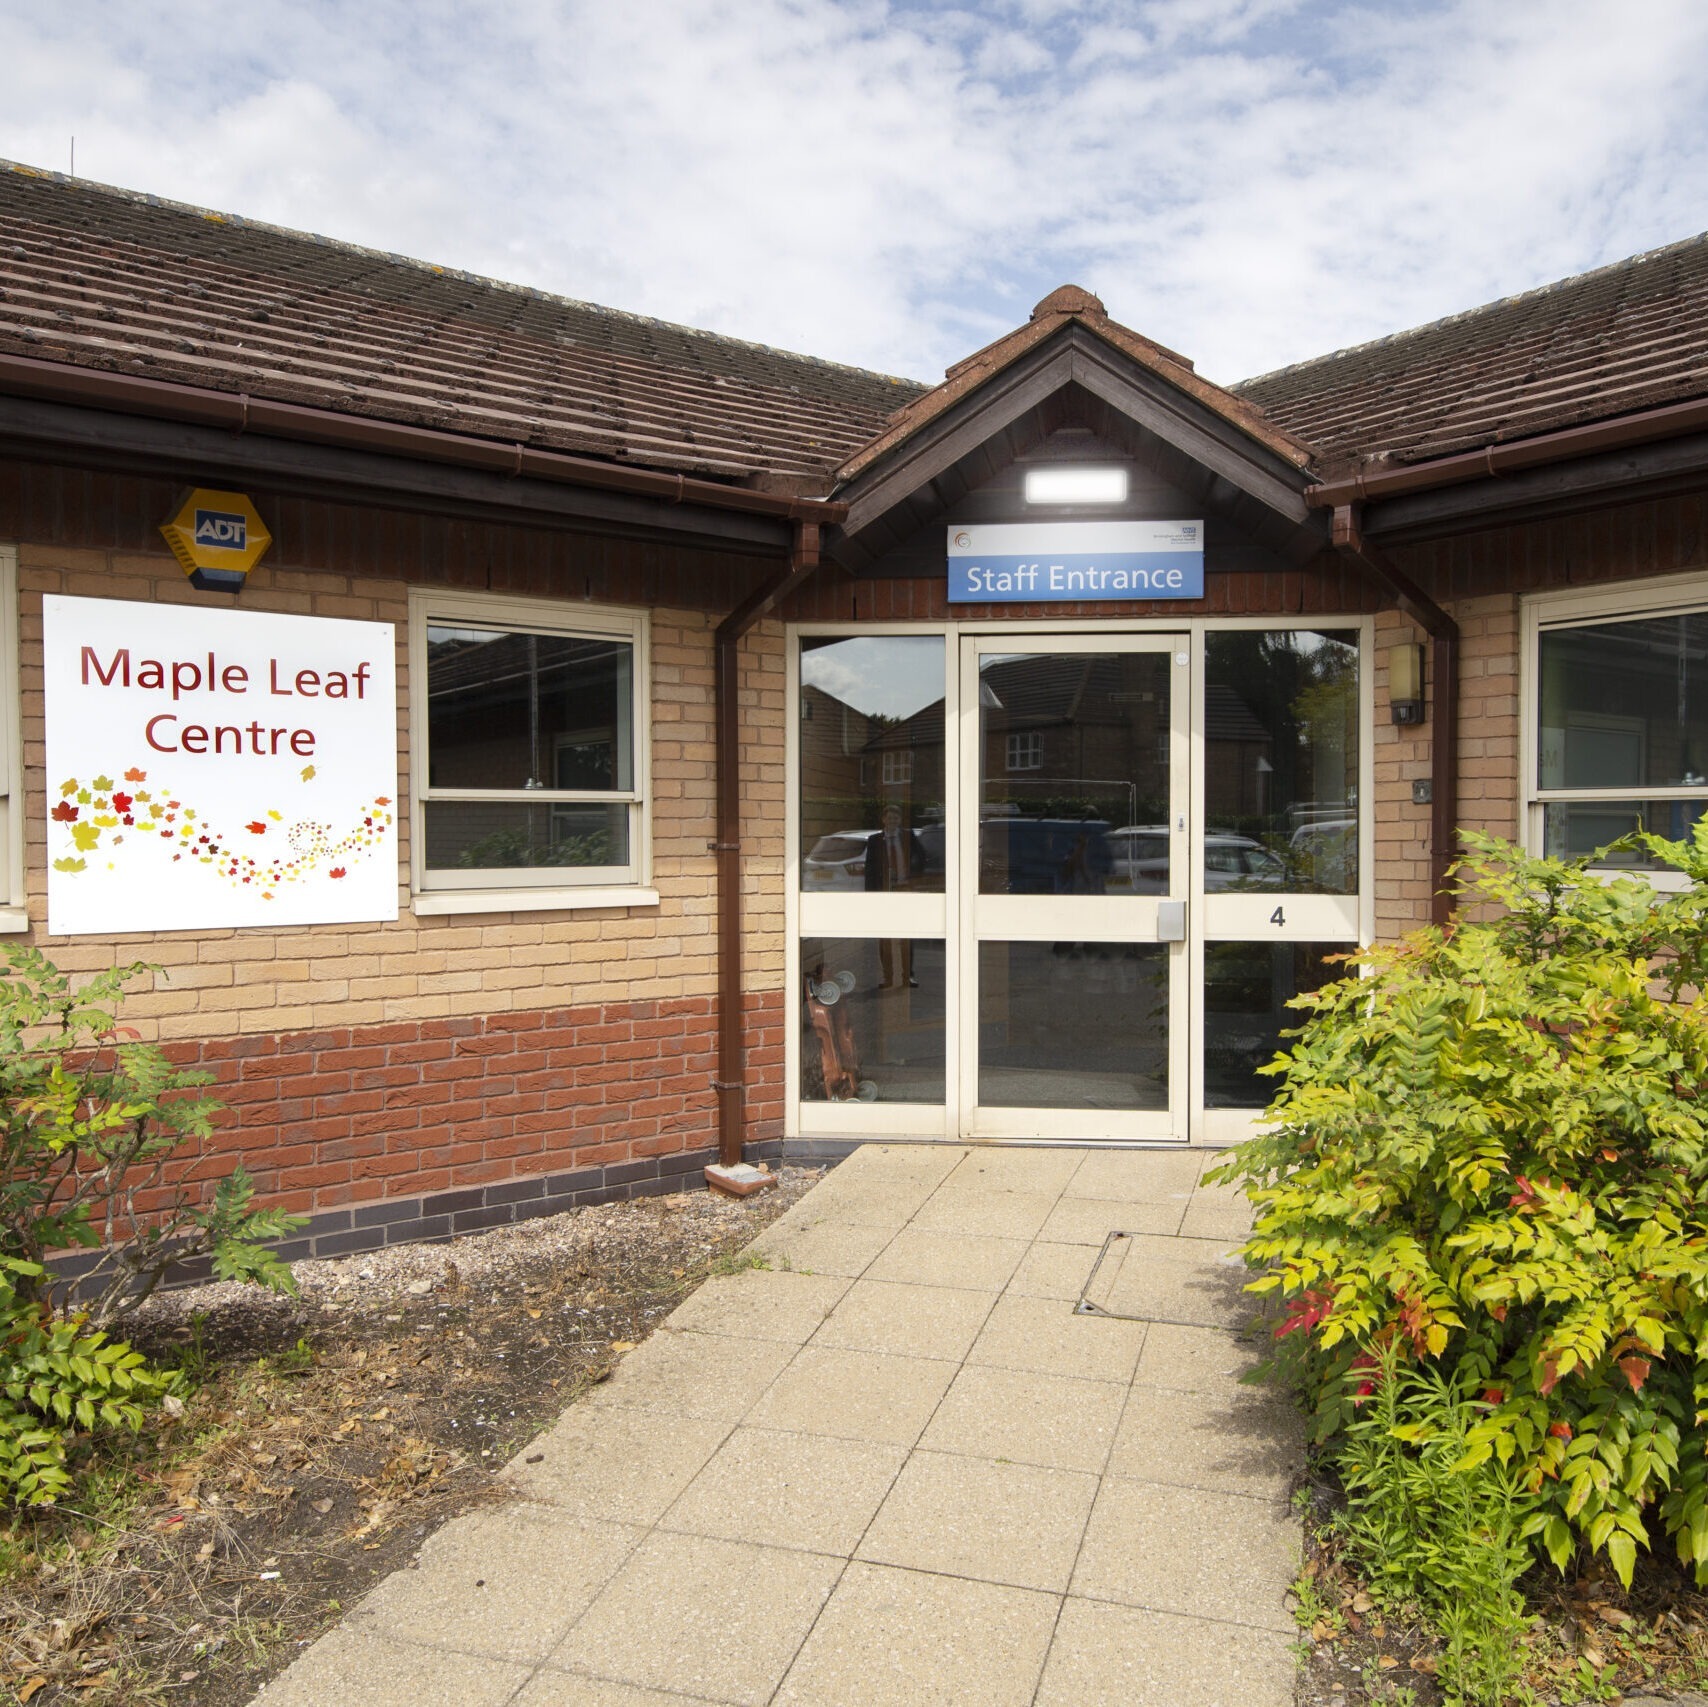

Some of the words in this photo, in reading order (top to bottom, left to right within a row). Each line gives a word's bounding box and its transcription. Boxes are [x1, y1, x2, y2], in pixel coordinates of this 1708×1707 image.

[196, 518, 245, 543] ADT
[967, 564, 1039, 592] Staff
[1049, 565, 1183, 591] Entrance
[81, 646, 249, 701] Maple
[270, 659, 370, 699] Leaf
[145, 713, 316, 757] Centre
[1270, 906, 1286, 926] 4
